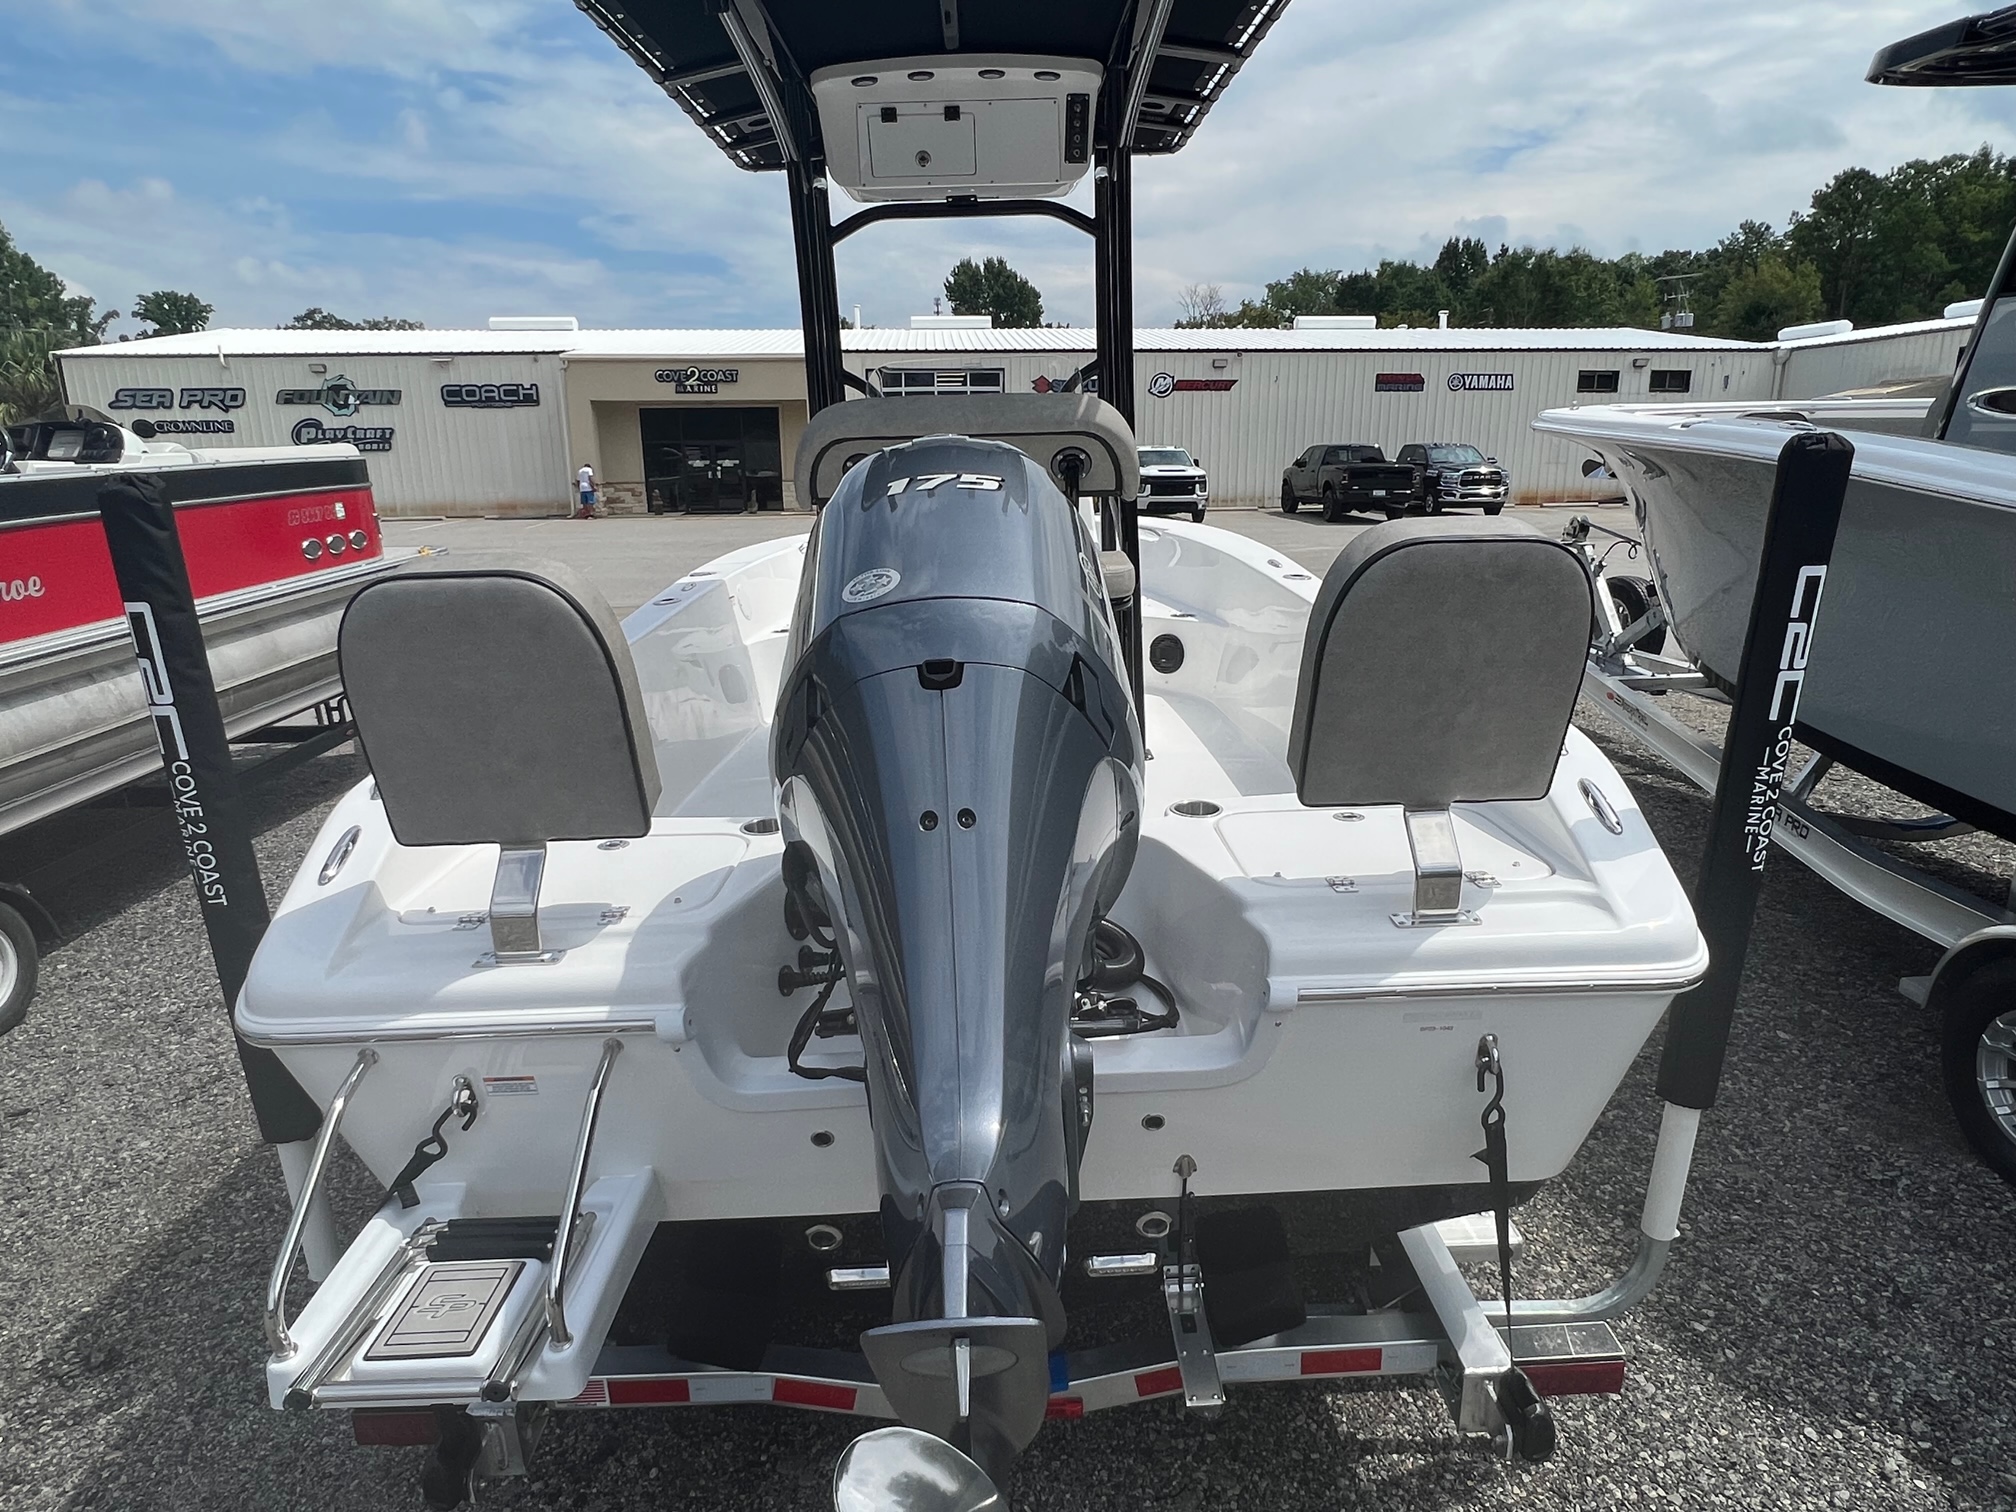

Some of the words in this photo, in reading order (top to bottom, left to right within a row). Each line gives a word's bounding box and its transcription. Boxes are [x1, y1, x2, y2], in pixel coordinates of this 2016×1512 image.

[656, 370, 687, 382] COVE
[686, 367, 700, 385] 2
[700, 370, 738, 382] COAST
[1176, 381, 1235, 390] MERCURY
[1463, 374, 1513, 389] YAMAHA
[277, 389, 401, 405] FOUNTAIN
[442, 384, 538, 401] COACH
[676, 384, 717, 393] MARINE
[113, 389, 173, 408] SEA
[180, 389, 244, 411] PRO
[154, 419, 233, 433] CROWNLINE
[887, 473, 1003, 496] 175
[1768, 564, 1828, 726] C2C
[1766, 724, 1793, 786] COVE
[171, 760, 204, 818] COVE
[1744, 765, 1769, 835] MARINE
[1763, 788, 1780, 802] 2
[172, 799, 199, 869] MARINE
[186, 814, 208, 836] 2
[1784, 814, 1810, 840] PRO
[1750, 805, 1776, 873] COAST
[192, 839, 229, 907] COAST
